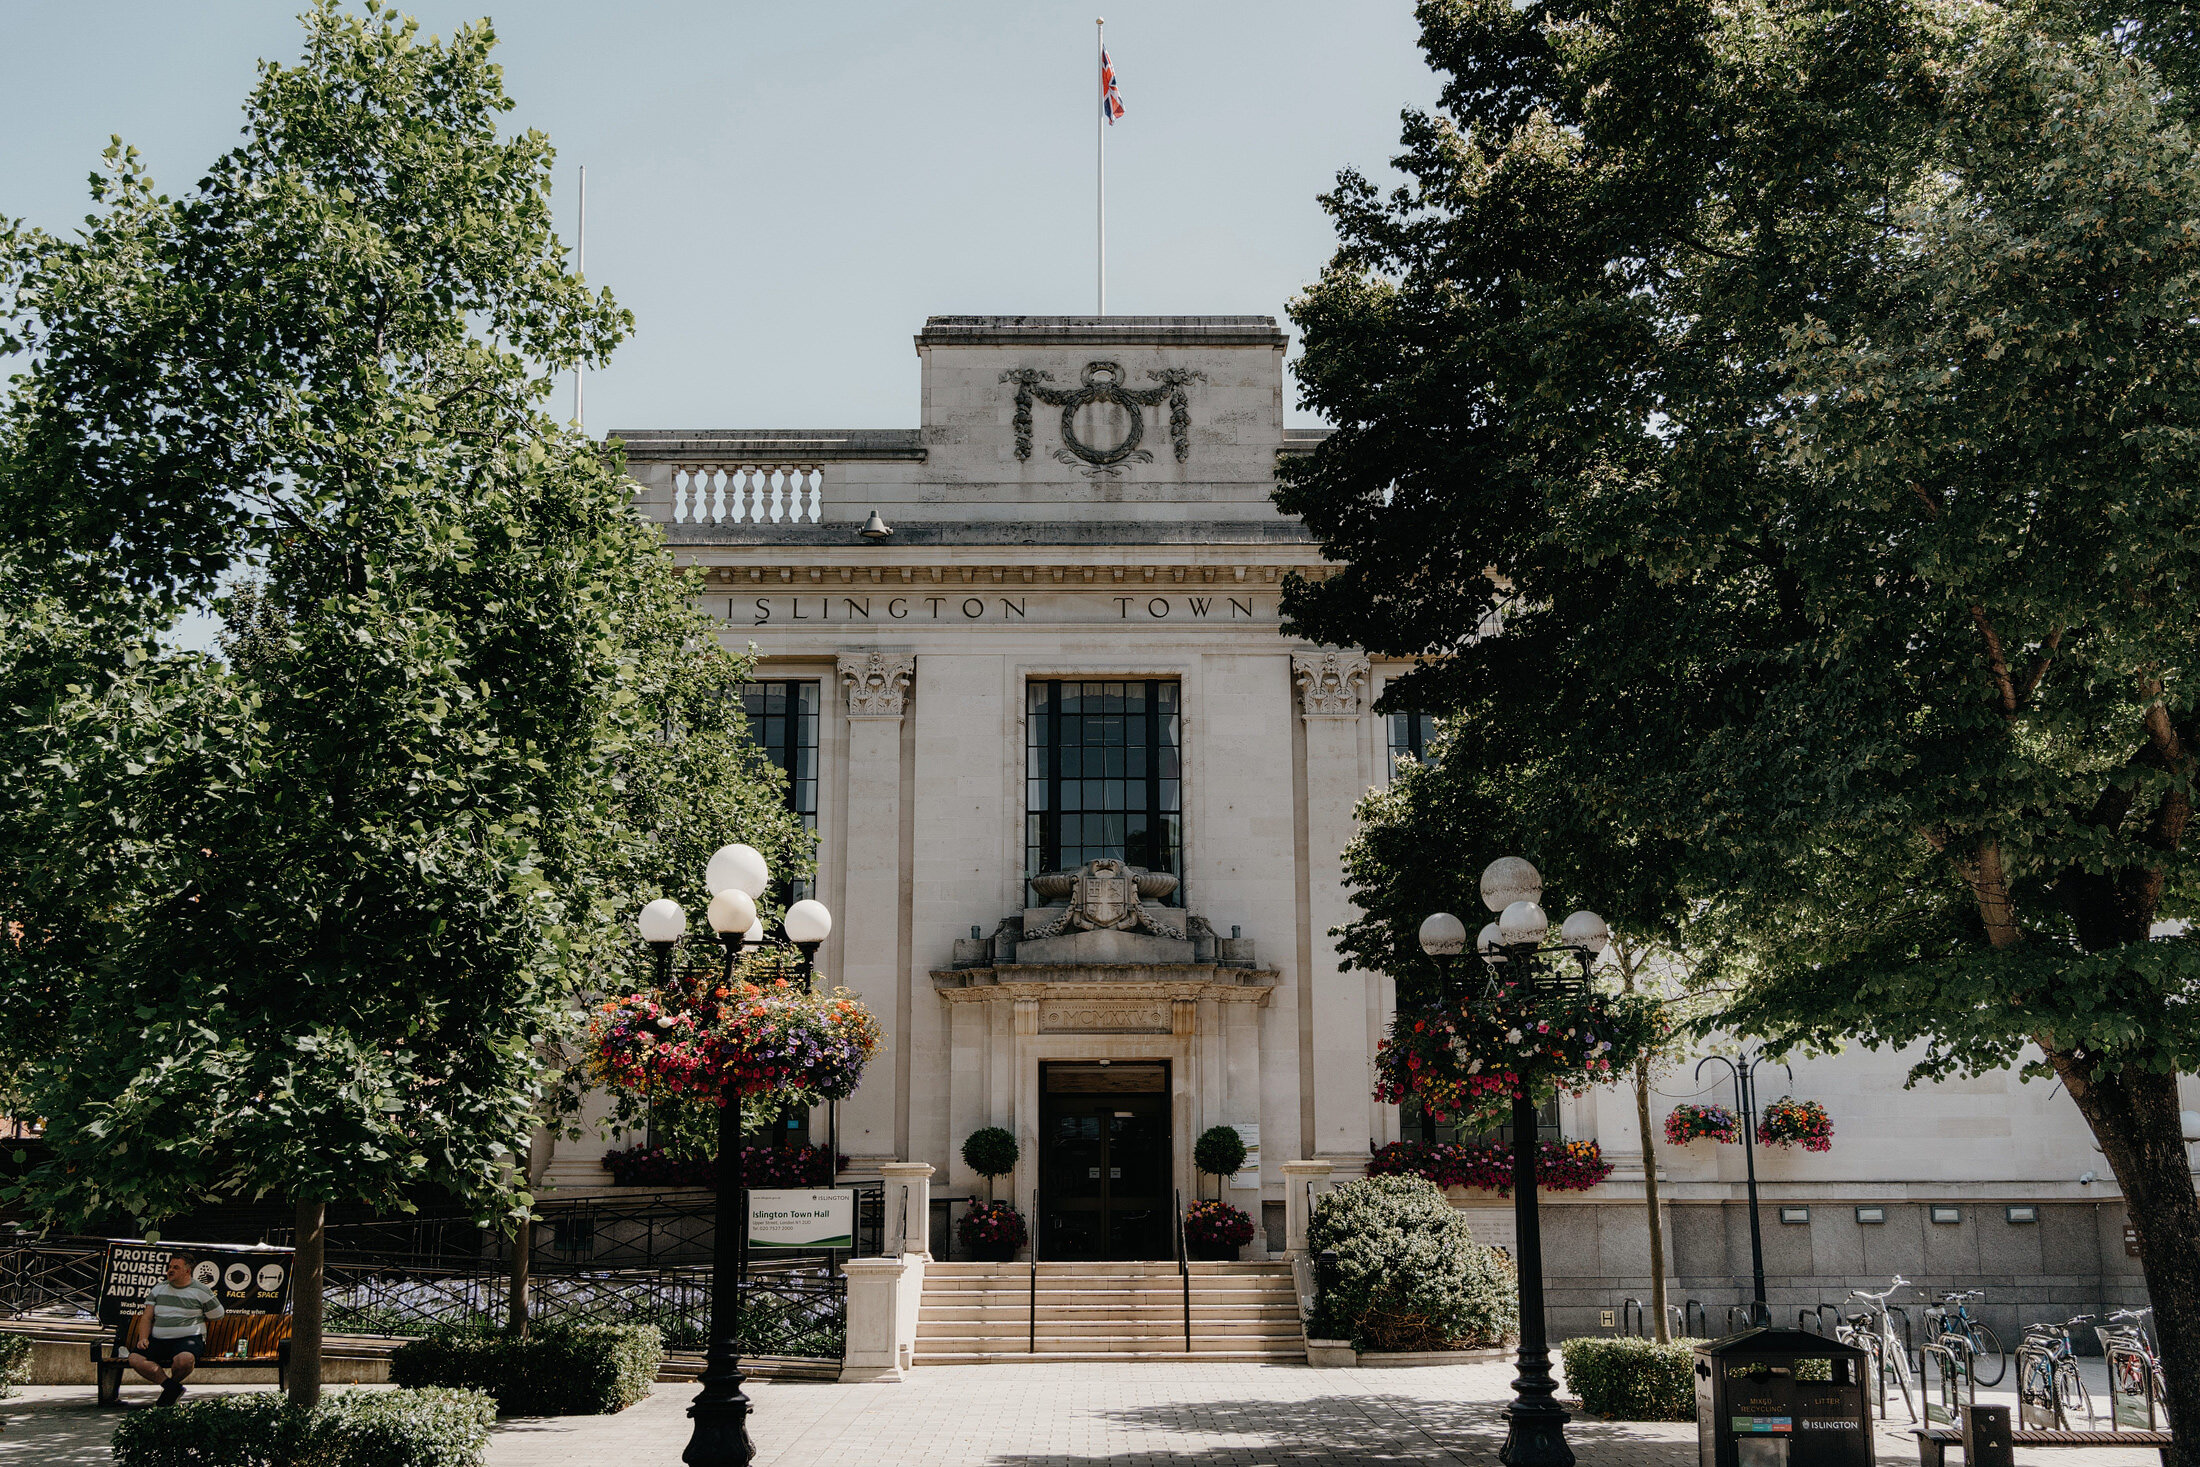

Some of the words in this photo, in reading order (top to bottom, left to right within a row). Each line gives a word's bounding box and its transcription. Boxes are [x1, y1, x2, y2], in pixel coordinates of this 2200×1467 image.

[727, 597, 1025, 620] ISLINGTON
[1113, 597, 1253, 619] TOWN
[752, 1210, 788, 1220] Islington
[790, 1210, 812, 1218] Town
[814, 1210, 830, 1218] Hall
[114, 1249, 173, 1263] PROTECT
[113, 1261, 168, 1275] YOURSEL
[107, 1285, 135, 1297] AND
[226, 1290, 246, 1298] FACE
[121, 1301, 136, 1309] Wash
[1741, 1405, 1782, 1413] RECYCLING
[1811, 1421, 1858, 1429] ISLINGTON
